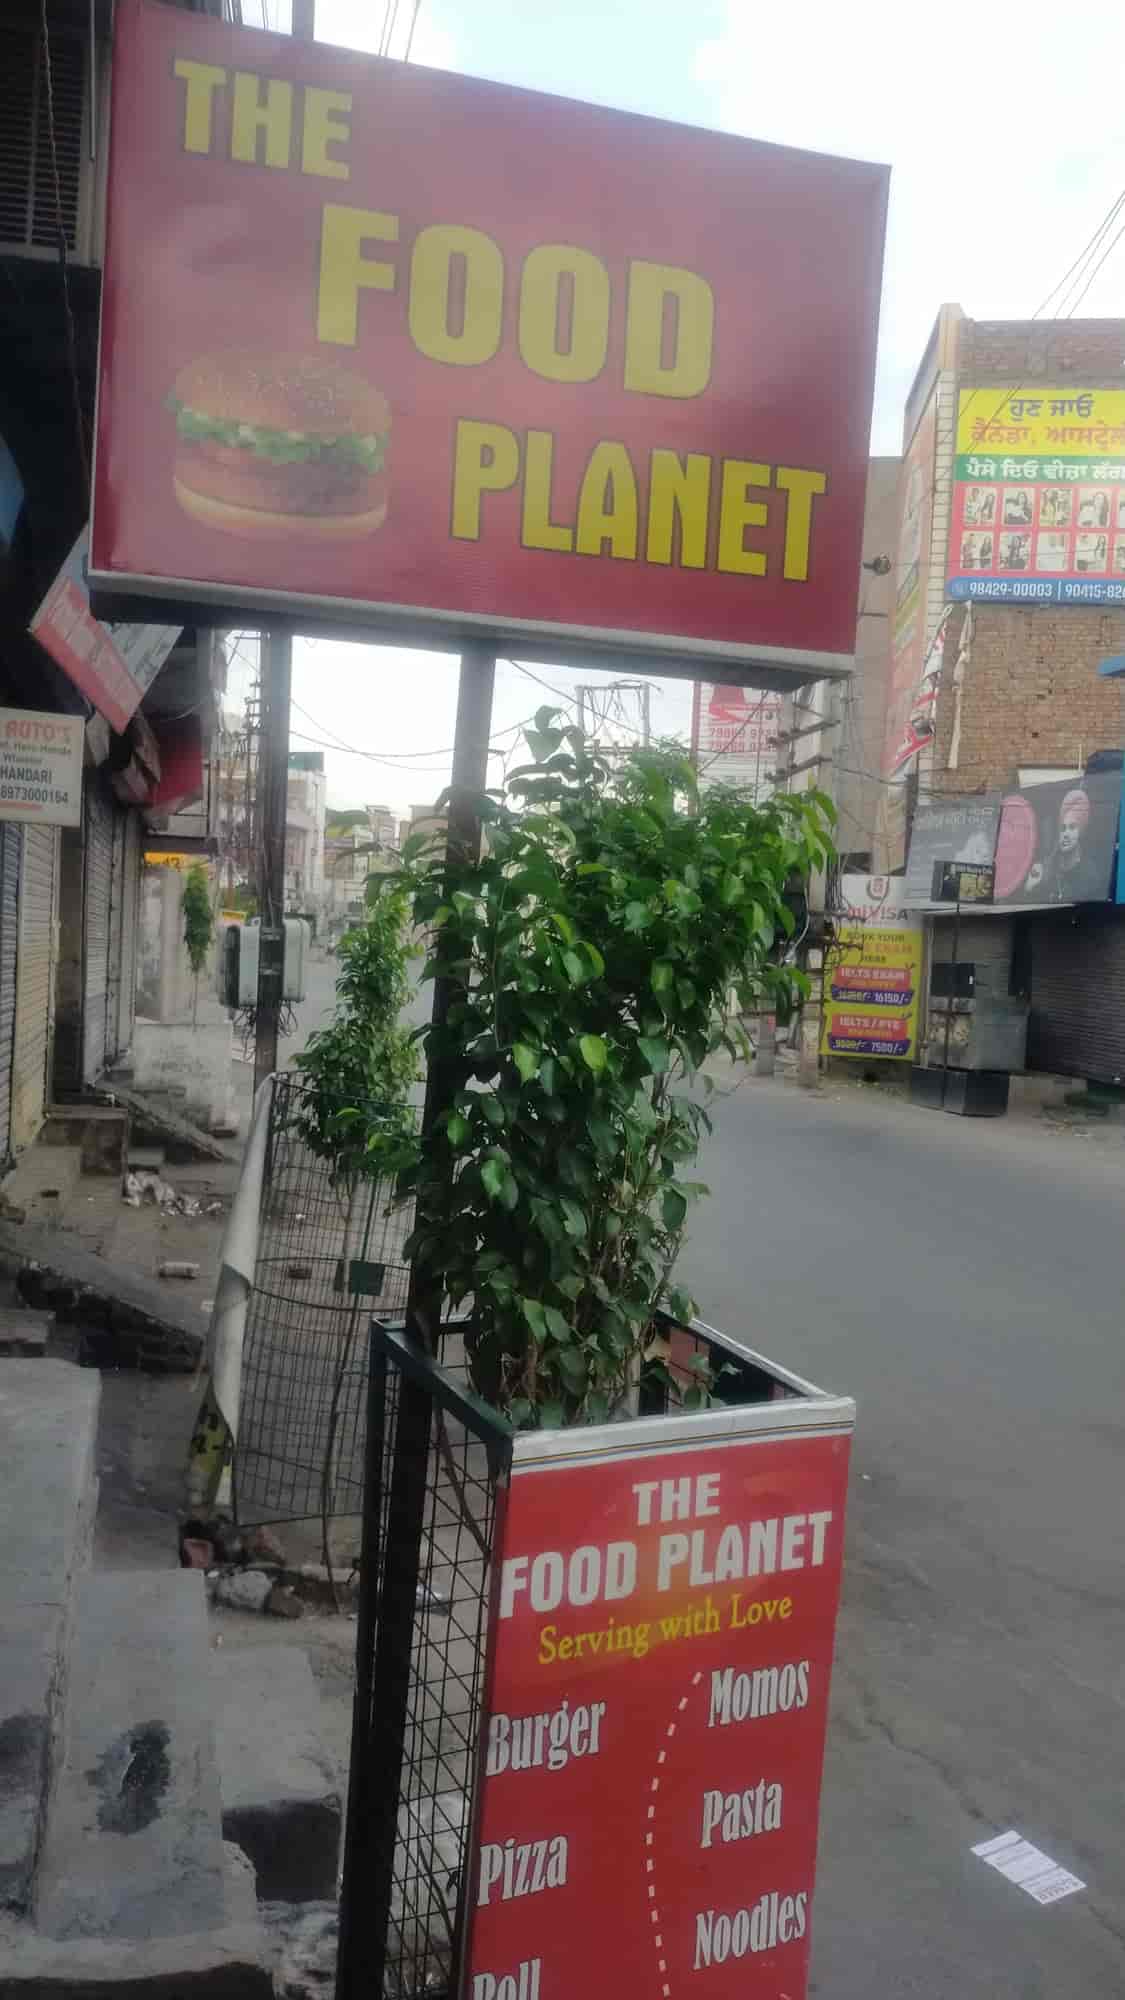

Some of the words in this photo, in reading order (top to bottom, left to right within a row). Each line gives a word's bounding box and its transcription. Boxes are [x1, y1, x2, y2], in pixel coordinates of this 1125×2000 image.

[174, 59, 353, 180] THE
[315, 202, 715, 399] FOOD
[450, 416, 828, 583] PLANET
[633, 1473, 721, 1526] THE
[499, 1541, 637, 1620] FOOD
[657, 1510, 833, 1592] PLANET
[538, 1617, 652, 1665] Serving
[660, 1597, 721, 1642] with
[731, 1594, 793, 1630] Love
[708, 1660, 810, 1728] Momos
[485, 1701, 606, 1777] Burger
[700, 1777, 783, 1849] Pasta
[477, 1835, 569, 1907] Pizza
[692, 1891, 807, 1971] Noodles
